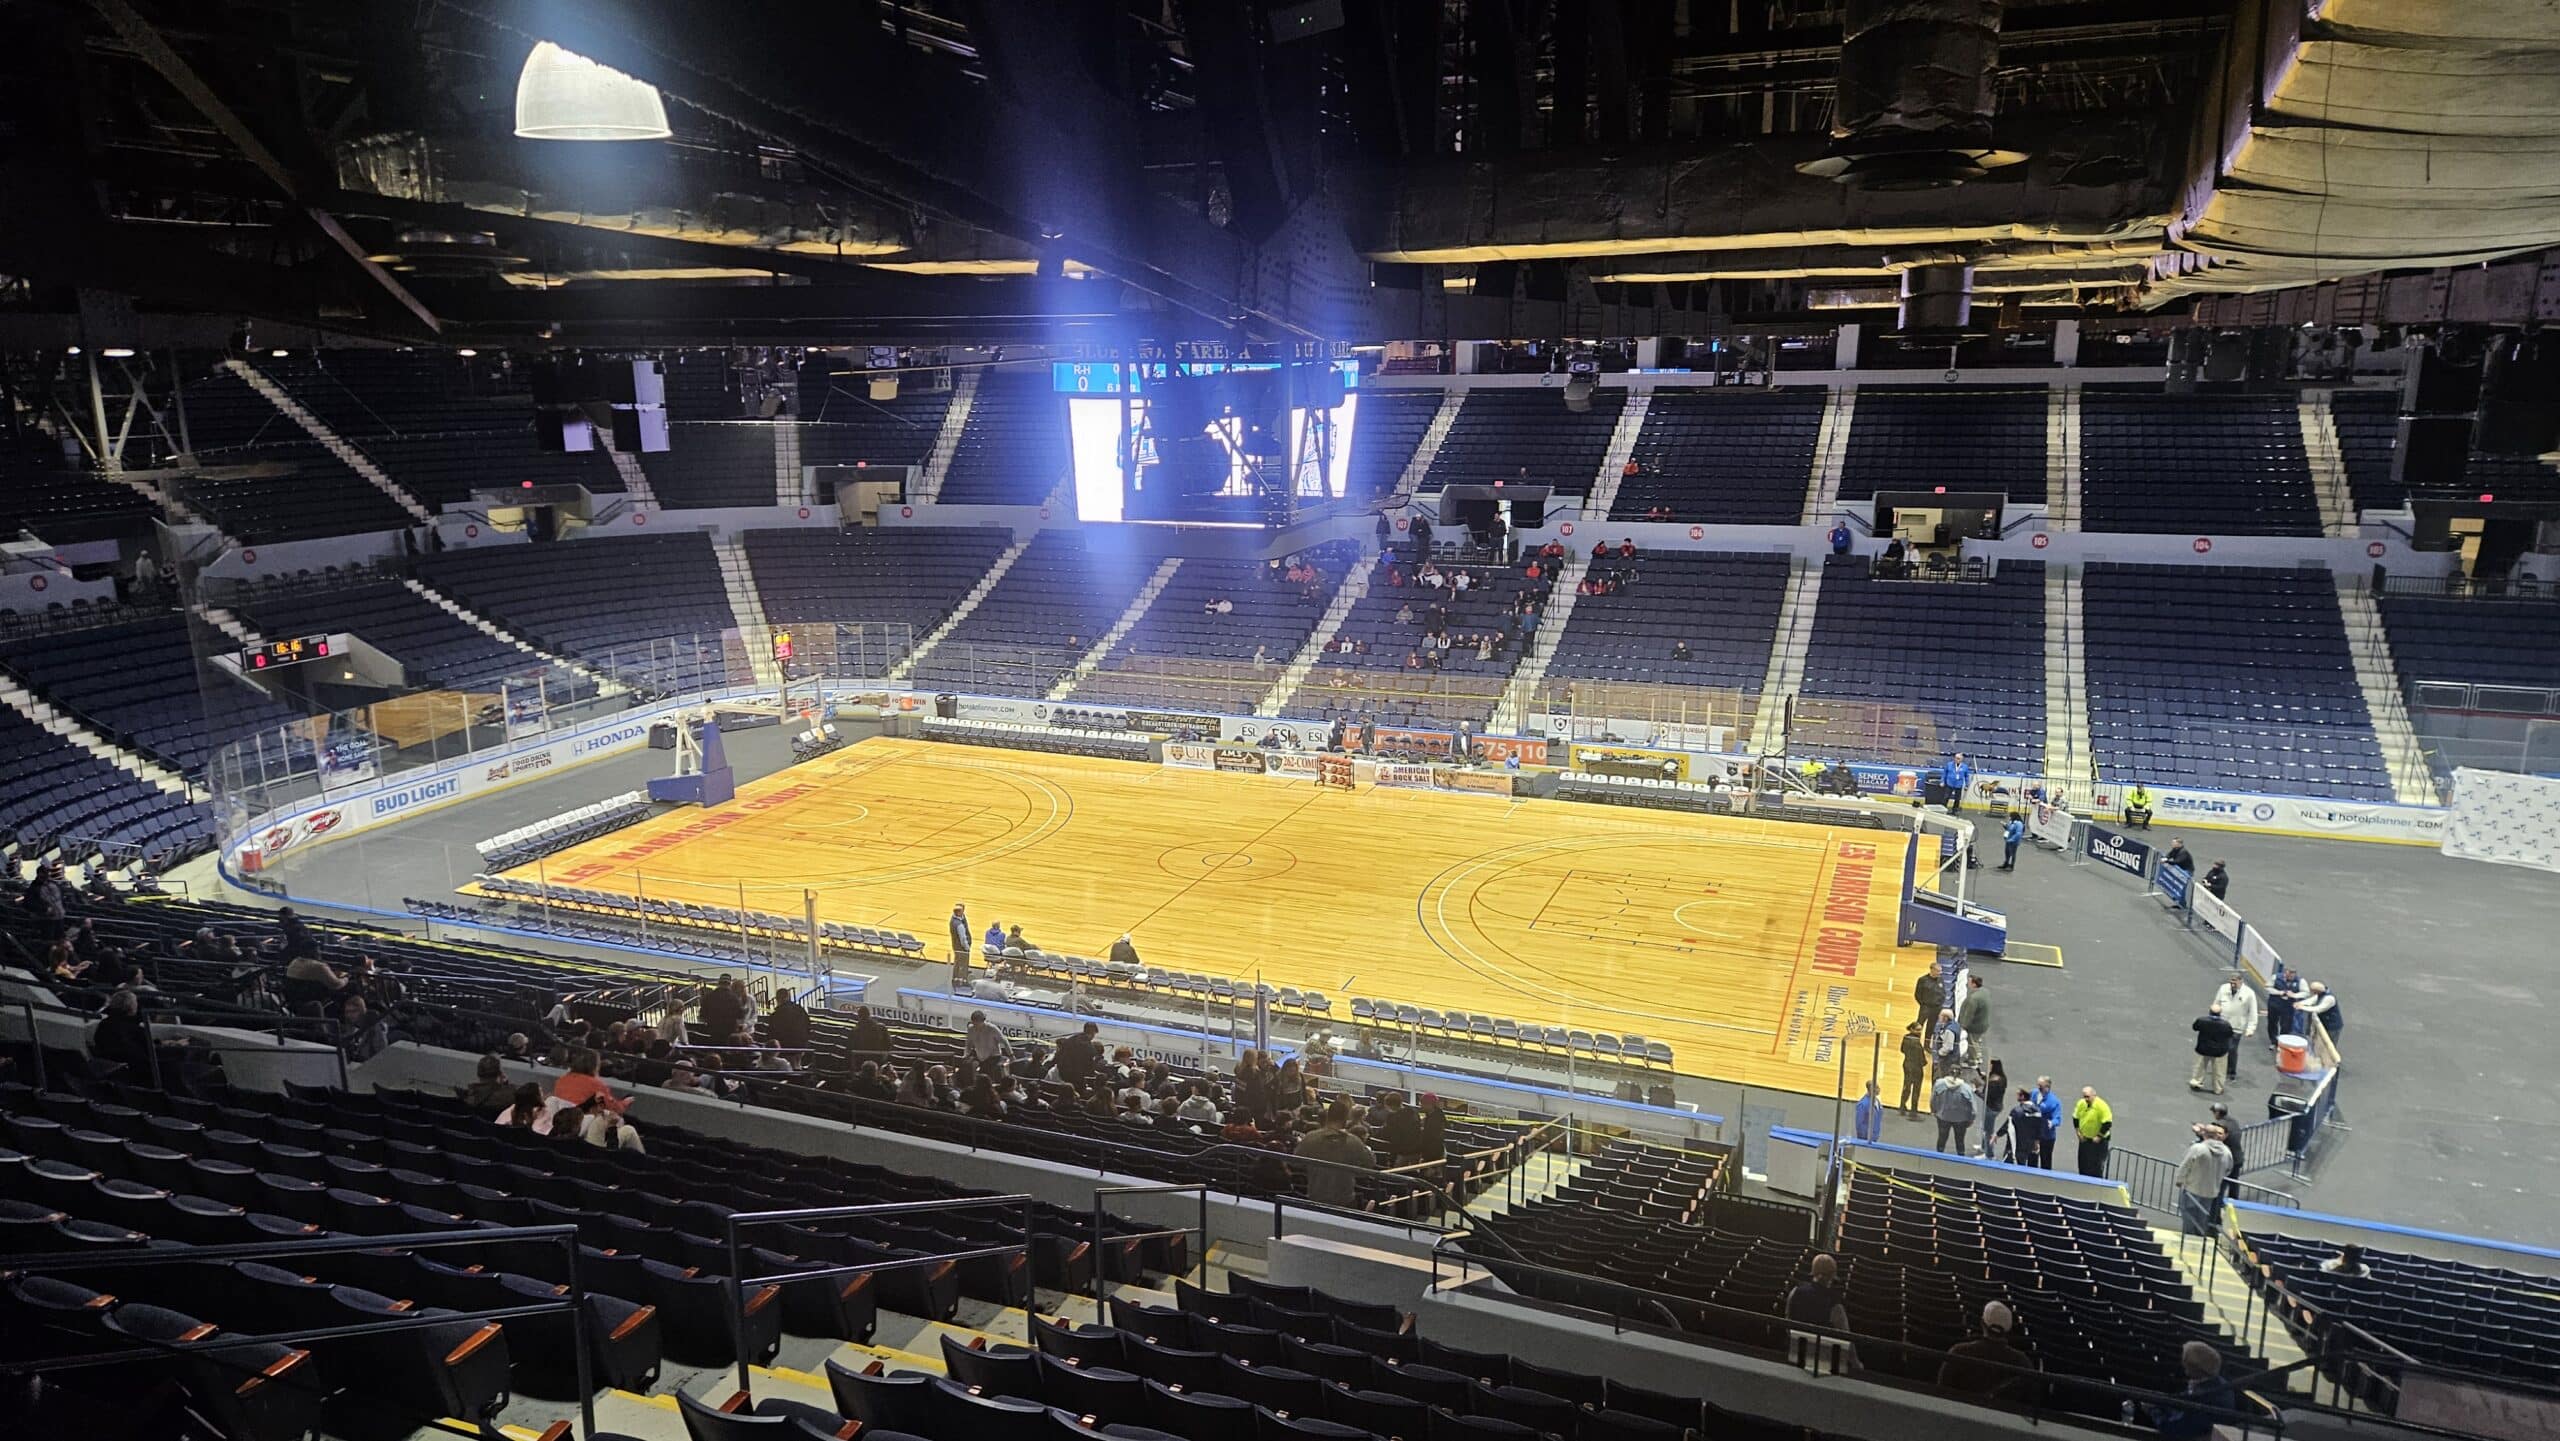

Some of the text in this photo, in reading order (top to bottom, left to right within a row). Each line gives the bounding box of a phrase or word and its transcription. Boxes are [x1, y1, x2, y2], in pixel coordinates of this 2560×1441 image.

[1077, 375, 1089, 393] 0
[1561, 525, 1572, 534] 107
[2195, 541, 2210, 549] 104
[318, 643, 328, 657] 0
[255, 653, 266, 668] 0
[587, 725, 646, 750] HONDA
[1241, 726, 1257, 737] ESL
[1308, 731, 1325, 743] ESL
[1185, 746, 1207, 760] UR
[1393, 766, 1430, 775] AMERICAN
[1858, 772, 1889, 780] SENECA
[1415, 775, 1430, 783] SALT
[375, 778, 457, 814] BUD LIGHT
[2163, 796, 2242, 813] SMART
[2301, 811, 2321, 820] NLL
[2092, 838, 2141, 871] SPALDING
[551, 863, 615, 883] LES
[1812, 927, 1864, 976] COURT
